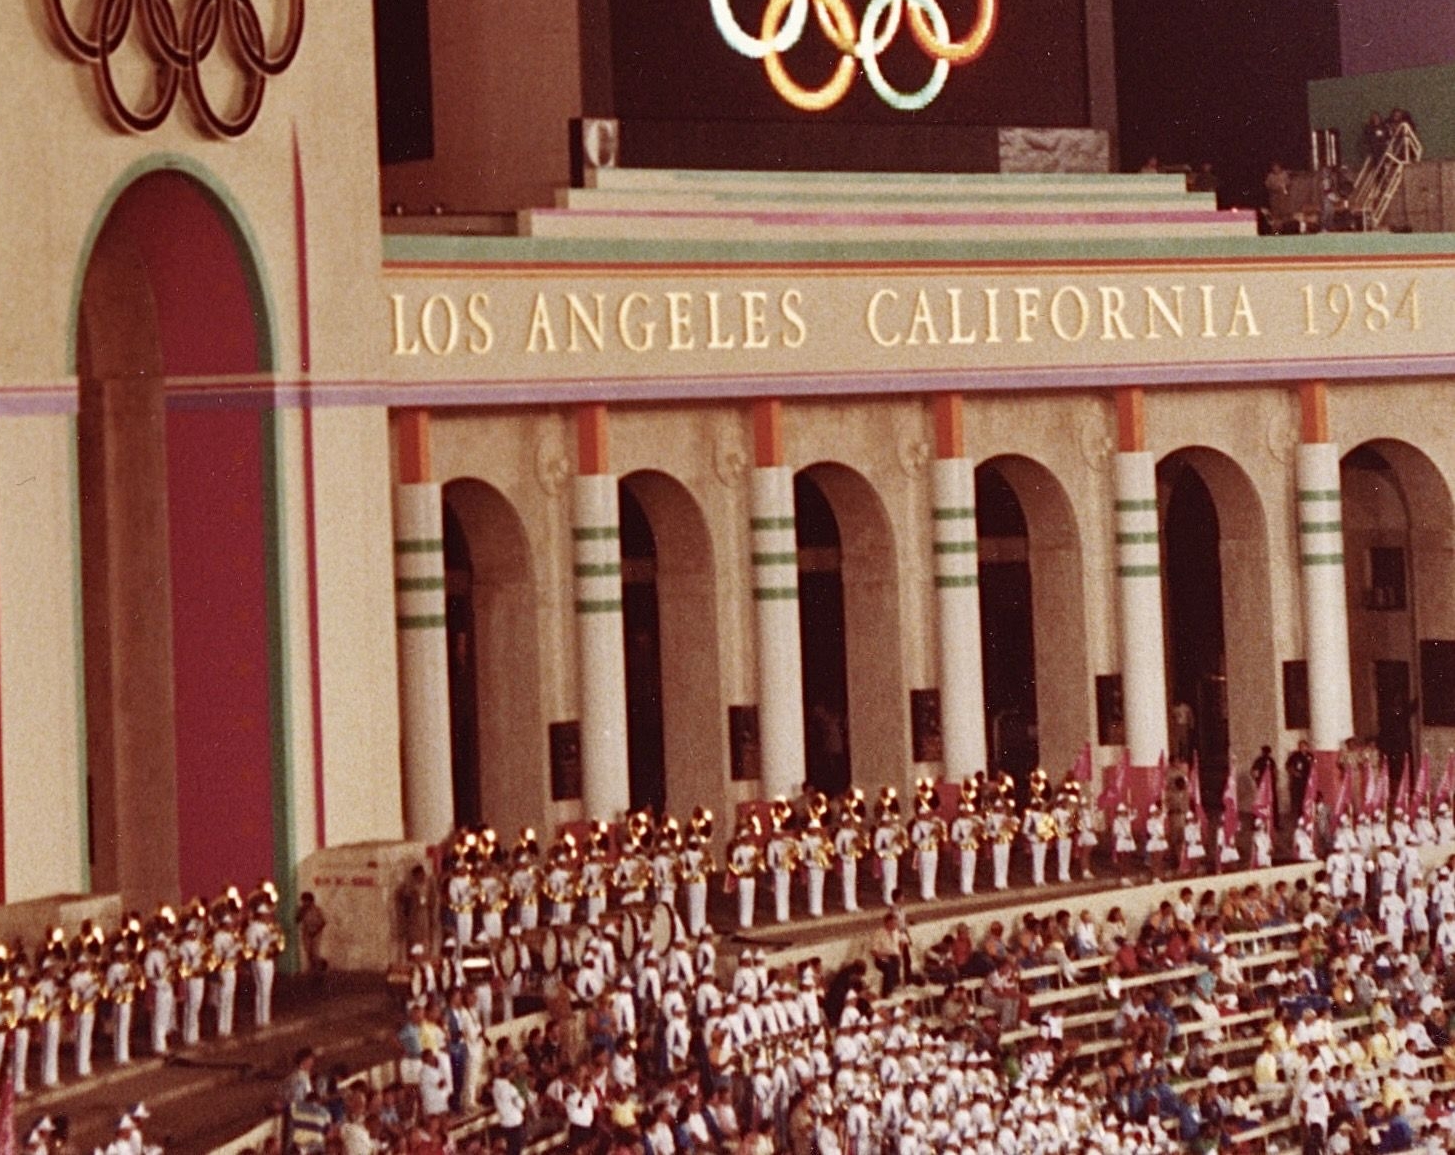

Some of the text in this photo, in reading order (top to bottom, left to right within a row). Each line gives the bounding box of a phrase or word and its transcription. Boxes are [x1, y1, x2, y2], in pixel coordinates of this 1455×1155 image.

[391, 279, 1426, 356] LOS ANGELES CALIFORNIA 1984
